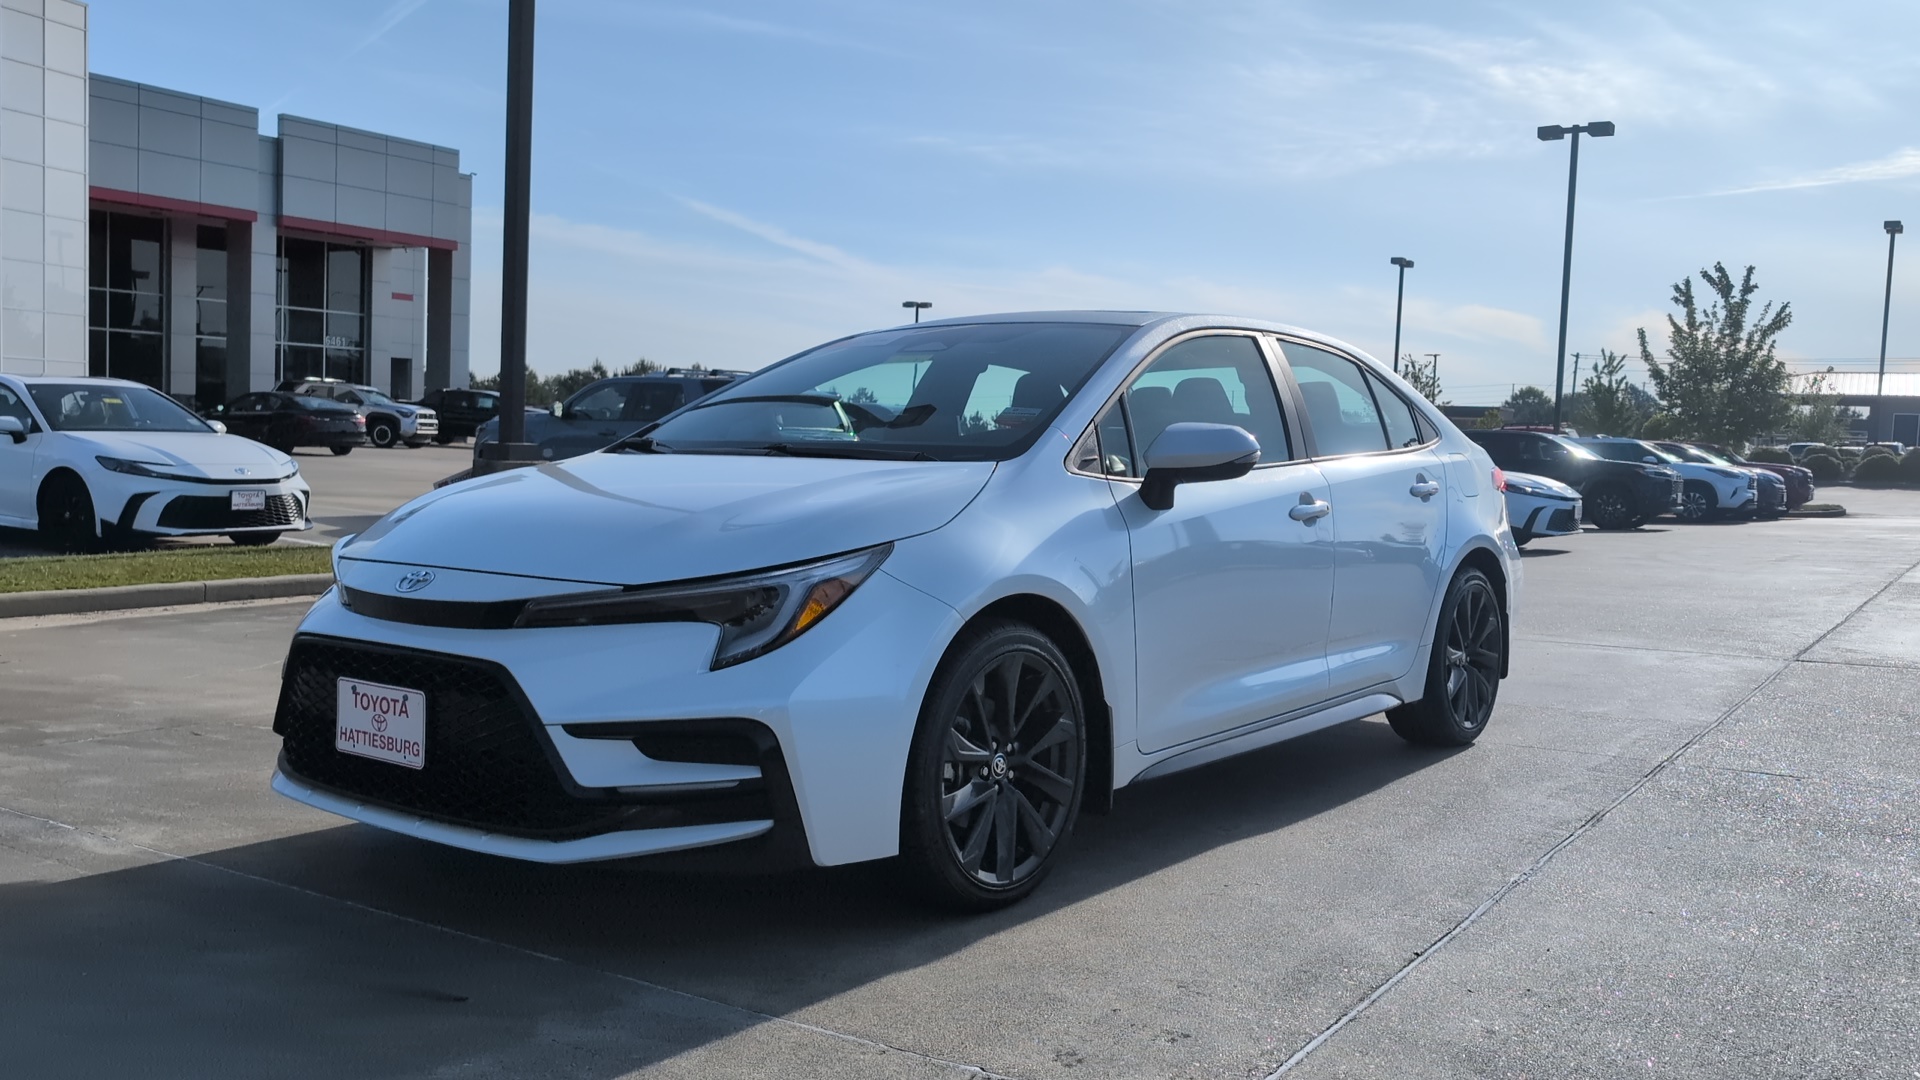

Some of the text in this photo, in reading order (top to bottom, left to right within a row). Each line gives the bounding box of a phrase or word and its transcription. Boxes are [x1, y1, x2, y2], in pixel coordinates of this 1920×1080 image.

[325, 336, 346, 347] 6461
[352, 691, 409, 718] TOYOTA
[339, 726, 420, 757] HATTIESBURG
